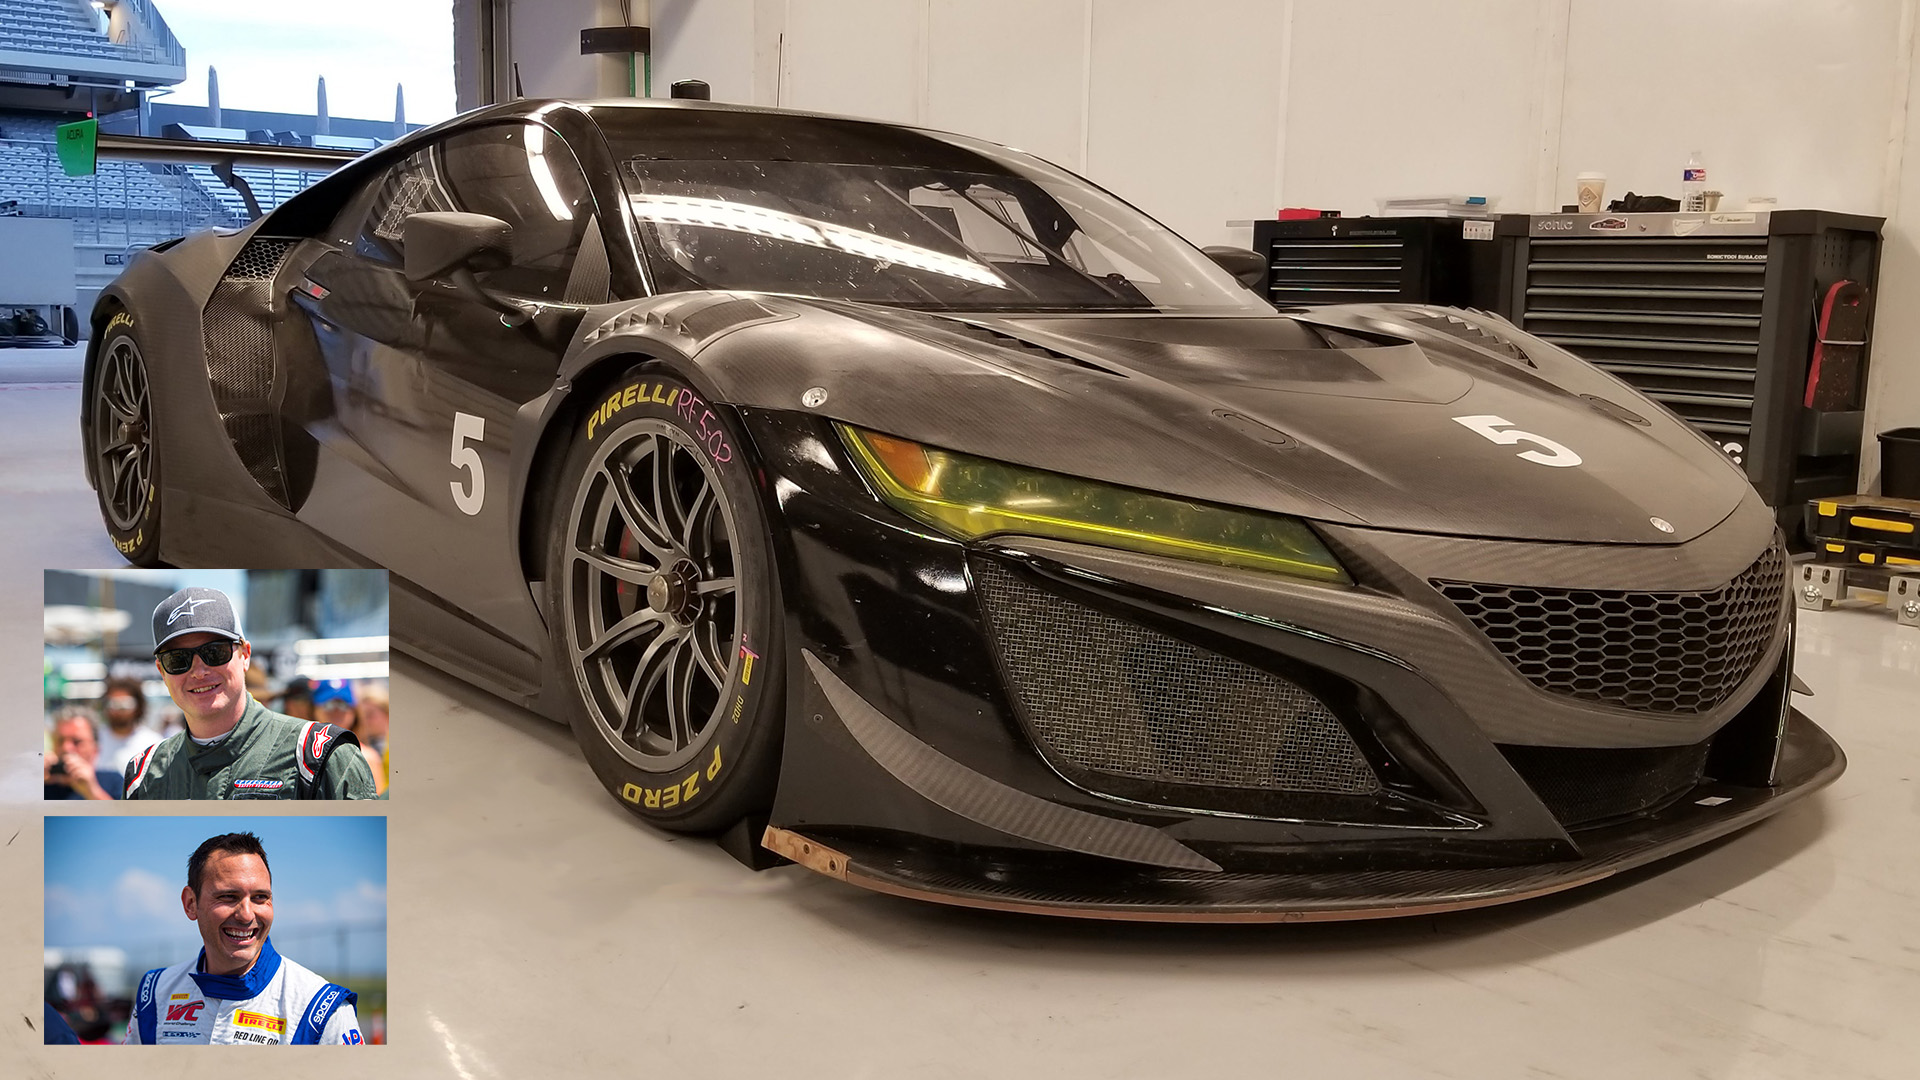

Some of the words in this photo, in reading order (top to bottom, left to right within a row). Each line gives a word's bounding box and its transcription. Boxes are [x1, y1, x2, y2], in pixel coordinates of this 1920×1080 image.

[586, 383, 679, 441] PIRELLI
[1451, 415, 1583, 467] 5
[450, 411, 486, 516] 5
[706, 744, 723, 782] P
[622, 770, 700, 809] ZERO
[166, 1002, 204, 1022] WC
[238, 1012, 285, 1032] PIRELLI
[313, 990, 338, 1024] sparco
[233, 1030, 249, 1041] RED
[249, 1033, 267, 1045] LINE
